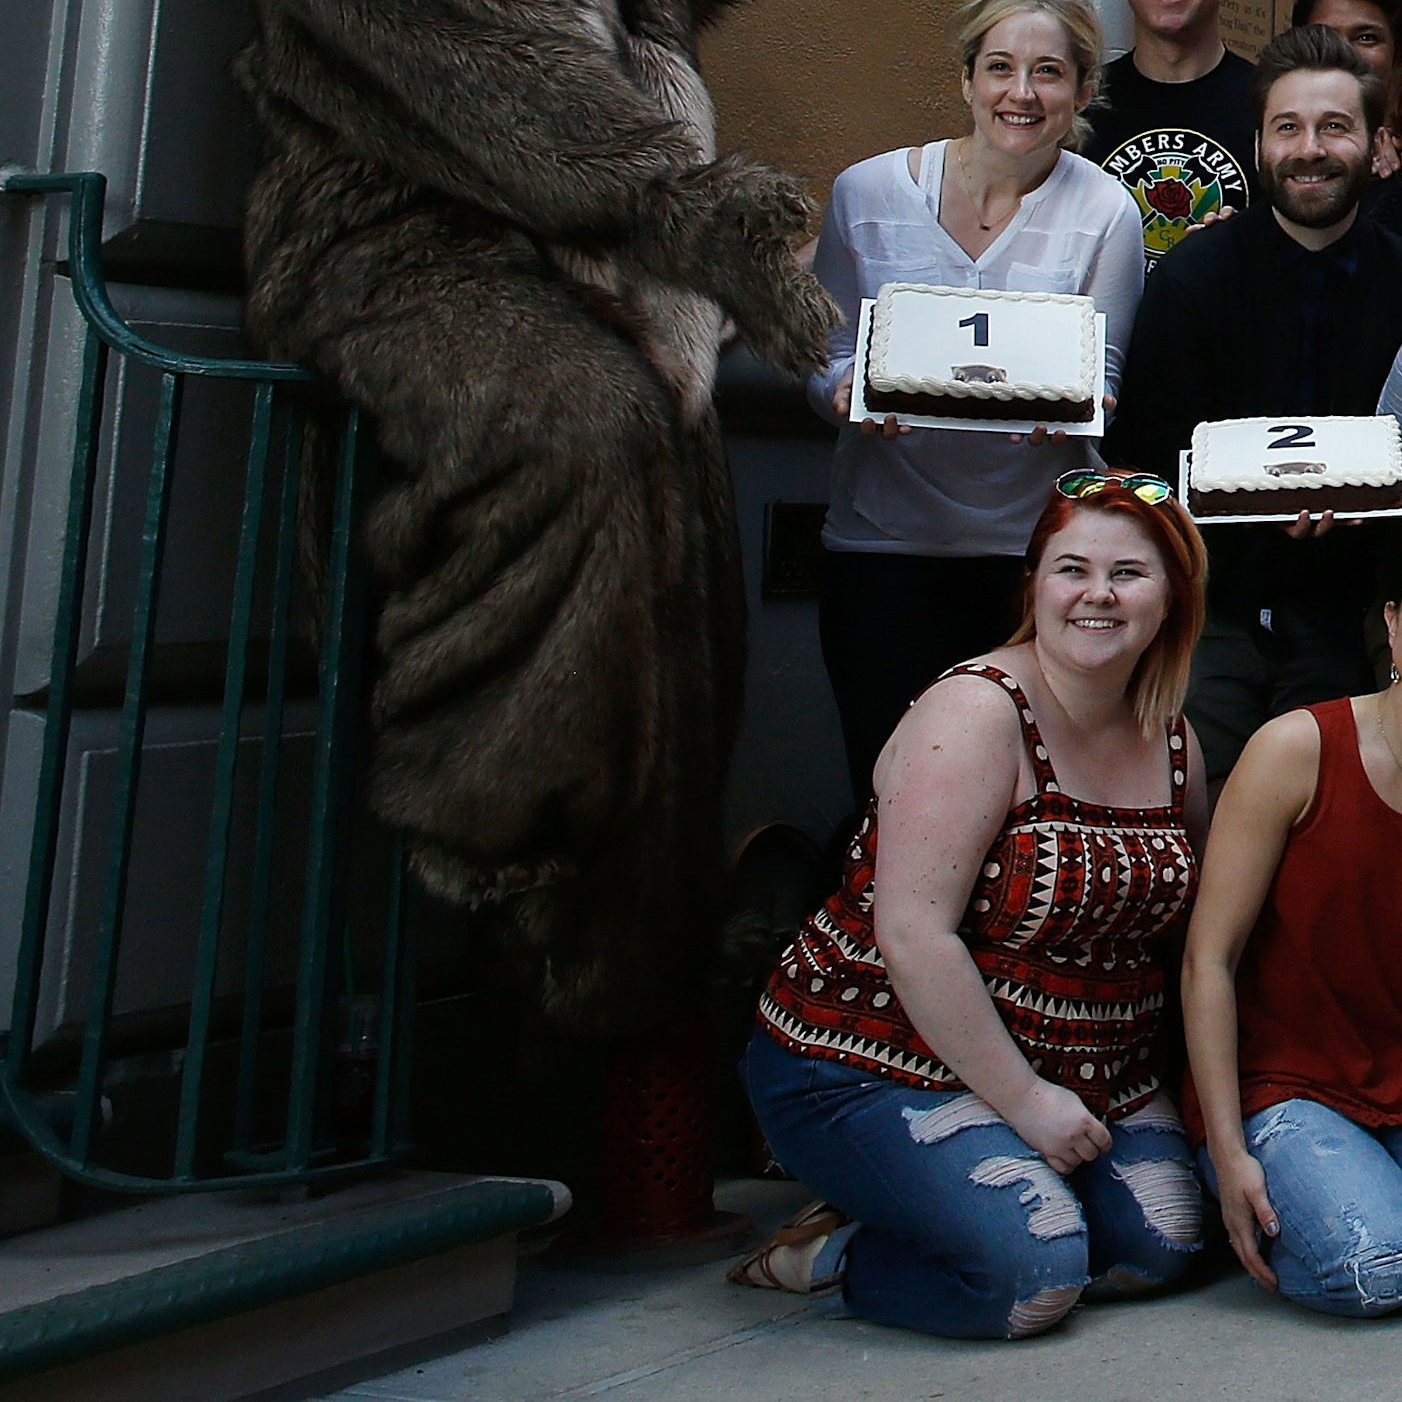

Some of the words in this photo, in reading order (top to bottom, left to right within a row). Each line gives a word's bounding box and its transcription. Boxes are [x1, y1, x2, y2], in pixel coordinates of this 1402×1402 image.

[1108, 134, 1185, 173] MBERS
[1192, 142, 1243, 191] ARMY
[1169, 158, 1186, 166] PITY
[958, 312, 992, 348] 1
[1266, 424, 1317, 451] 2
